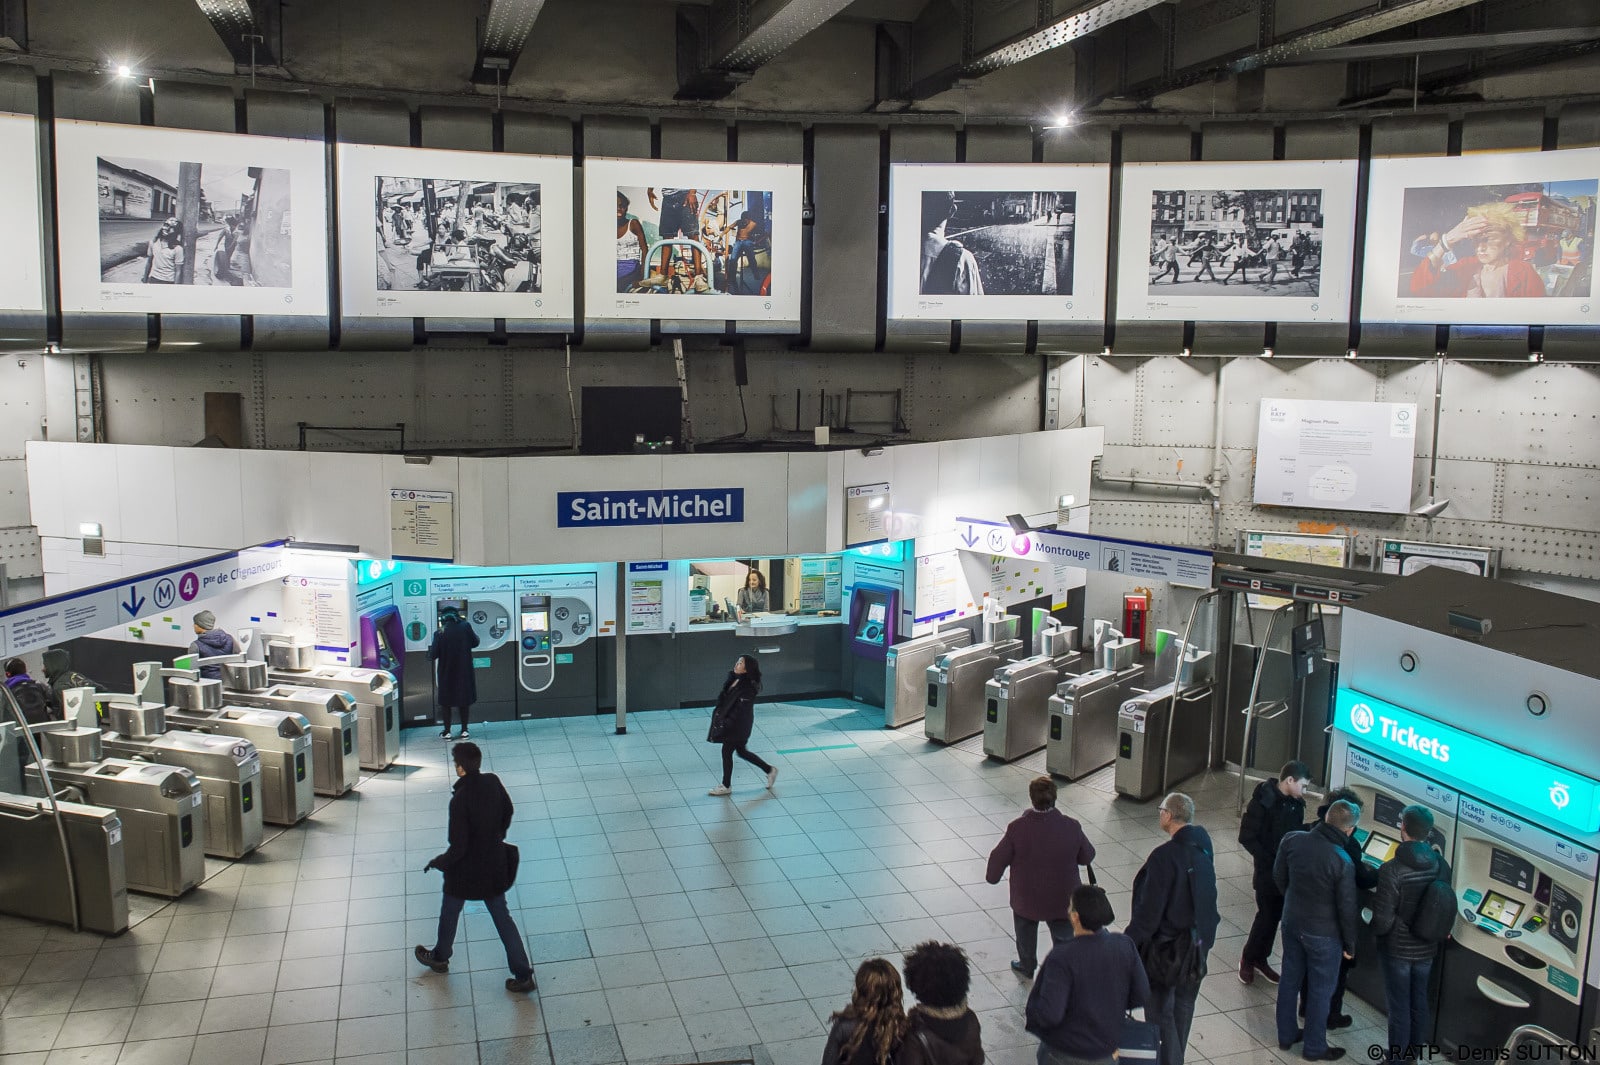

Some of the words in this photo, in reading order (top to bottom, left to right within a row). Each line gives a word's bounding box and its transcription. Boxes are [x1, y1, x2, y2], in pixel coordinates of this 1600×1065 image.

[571, 493, 732, 521] Saint-Michel
[1035, 542, 1091, 560] Montrouge
[217, 573, 228, 584] de
[230, 559, 282, 580] Clignancourt
[1379, 715, 1450, 763] Tickets
[1350, 751, 1370, 766] Tickets
[1461, 800, 1485, 816] Tickets
